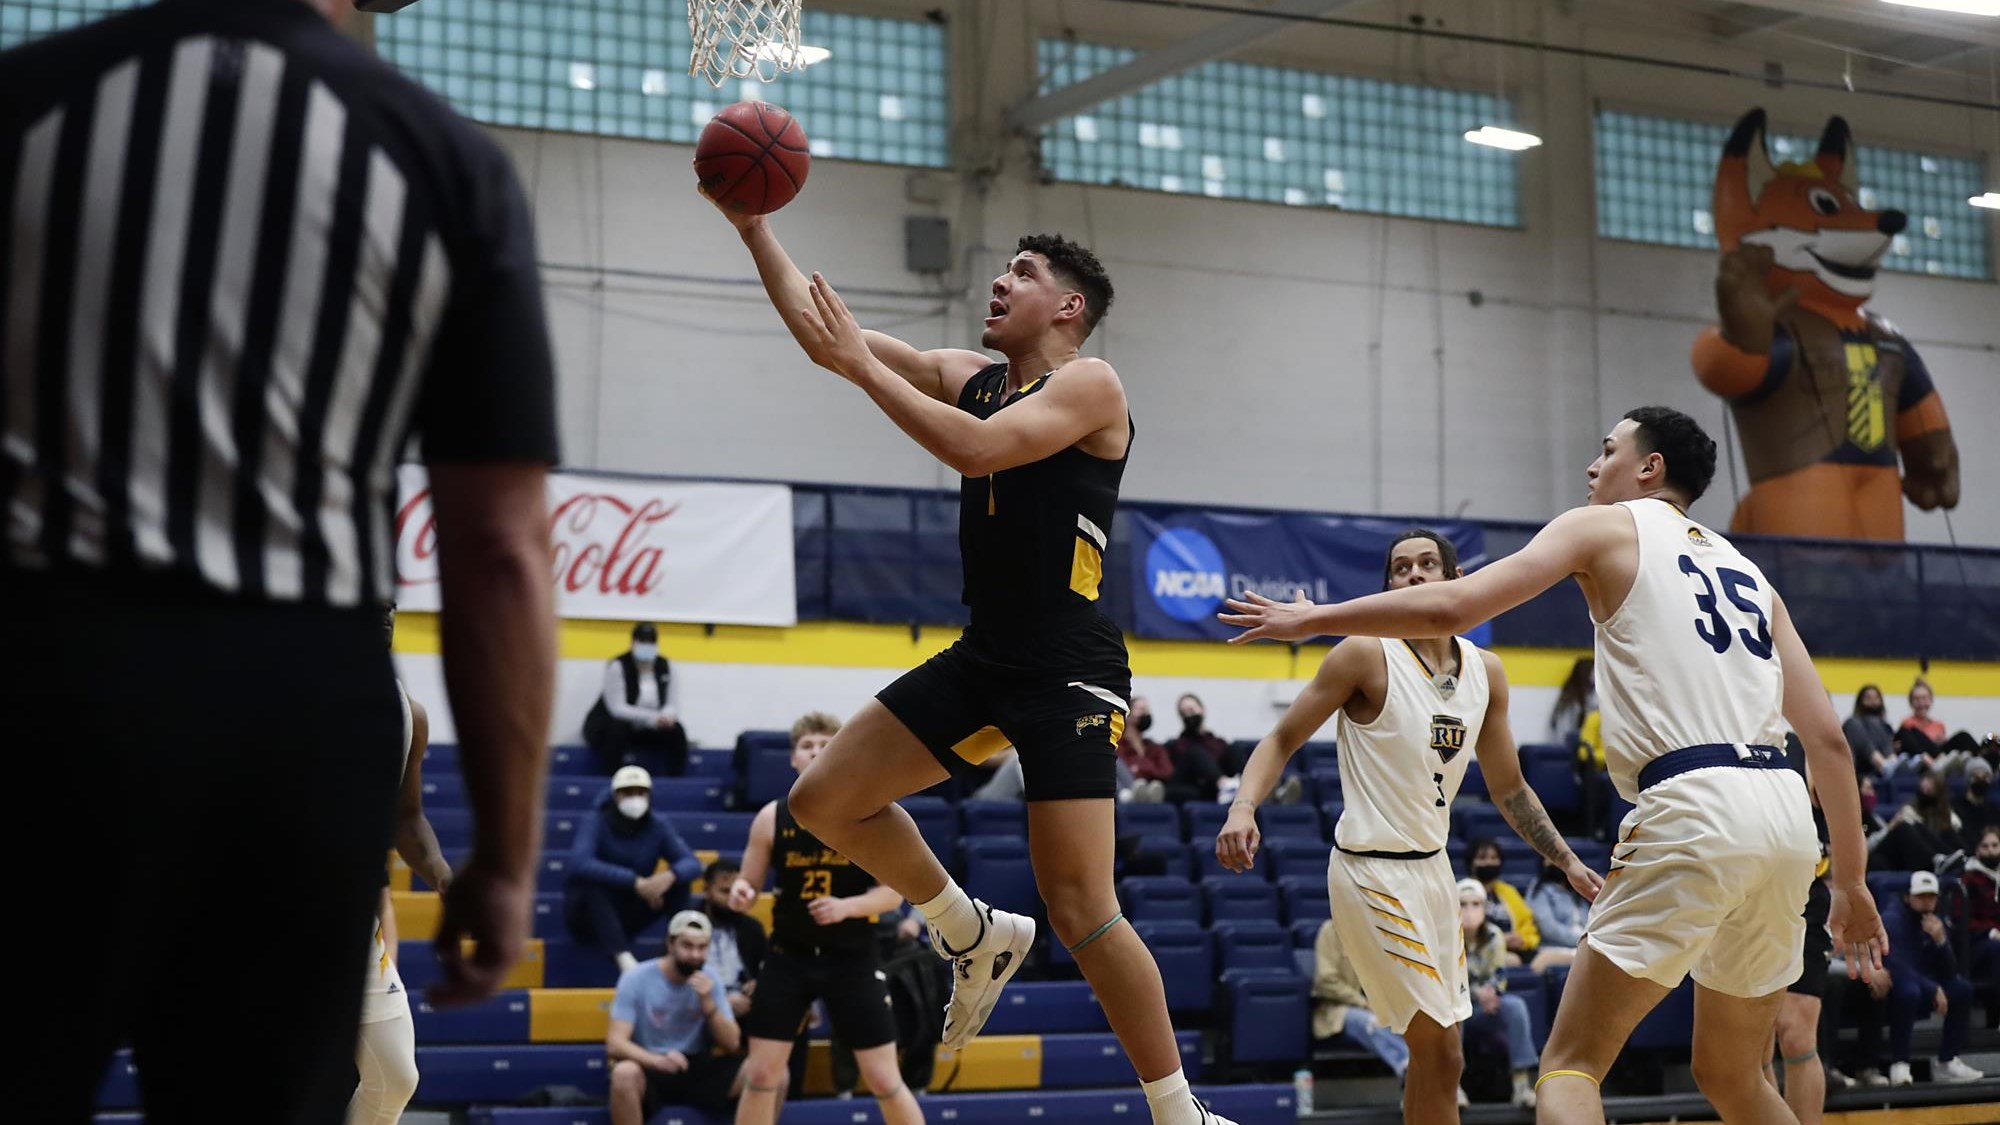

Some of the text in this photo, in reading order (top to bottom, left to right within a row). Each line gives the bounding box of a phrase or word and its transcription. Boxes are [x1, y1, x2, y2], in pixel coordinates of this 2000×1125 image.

[1154, 569, 1227, 599] NCAA
[1677, 554, 1773, 661] 35
[1431, 723, 1468, 750] RU
[801, 870, 832, 899] 23
